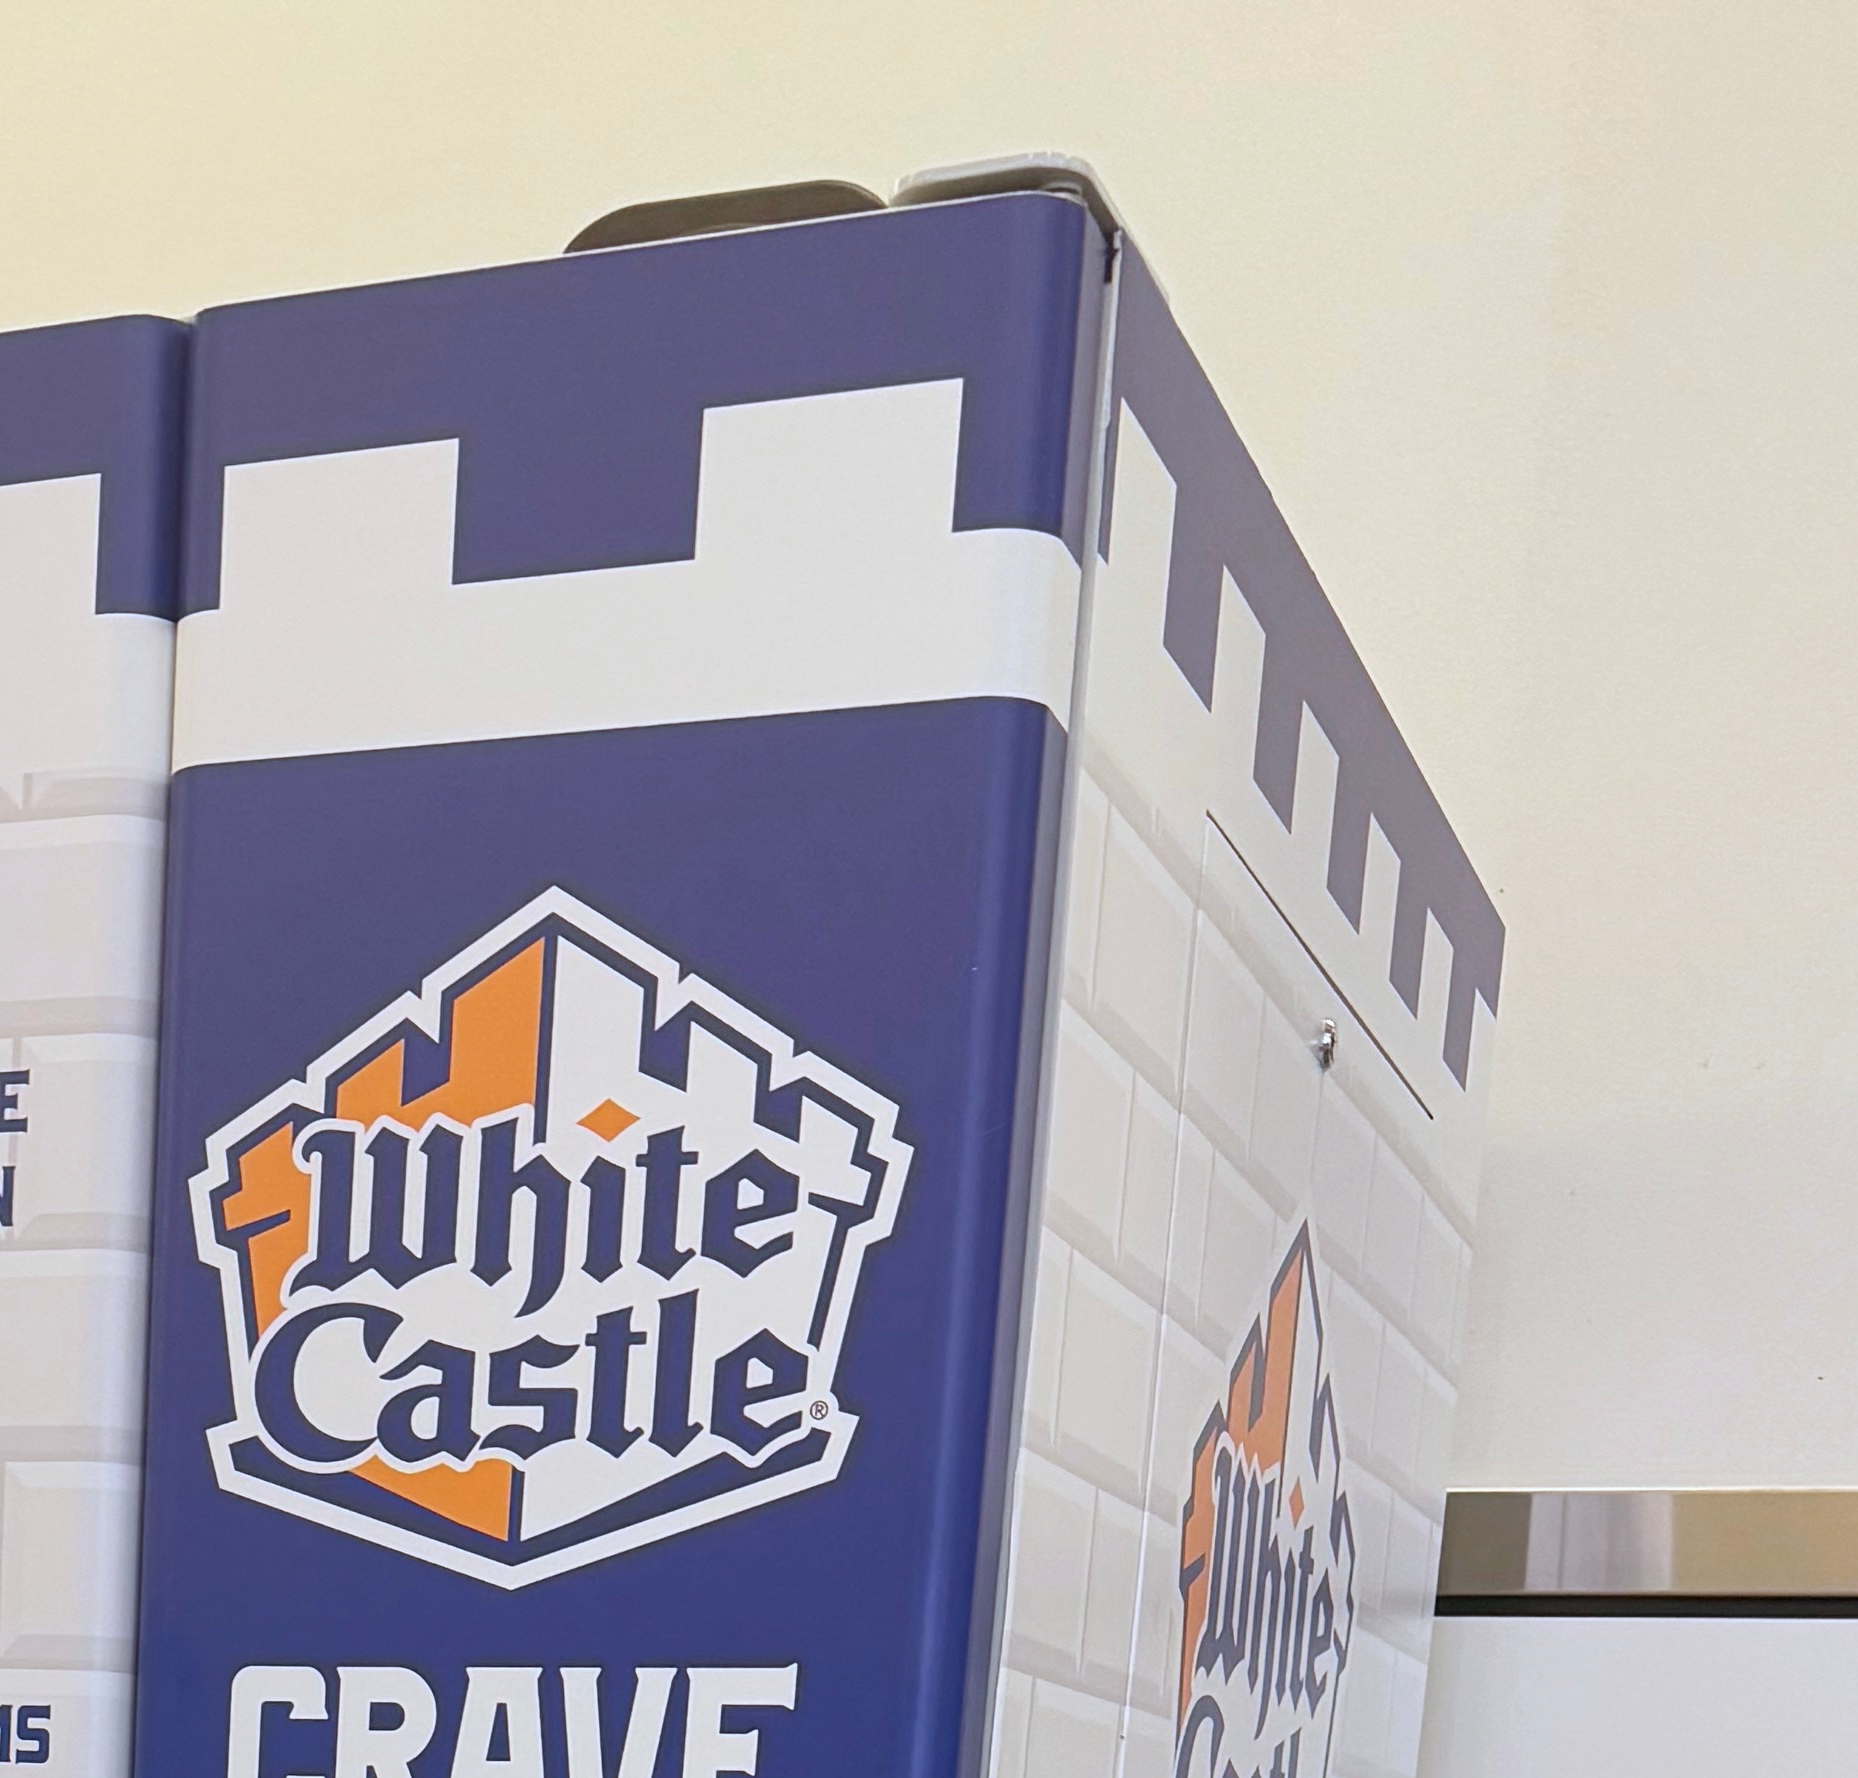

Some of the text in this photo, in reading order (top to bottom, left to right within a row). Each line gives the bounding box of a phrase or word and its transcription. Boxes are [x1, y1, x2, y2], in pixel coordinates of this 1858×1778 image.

[290, 1098, 797, 1319] White
[254, 1289, 810, 1463] Castle
[1195, 1446, 1334, 1740] White
